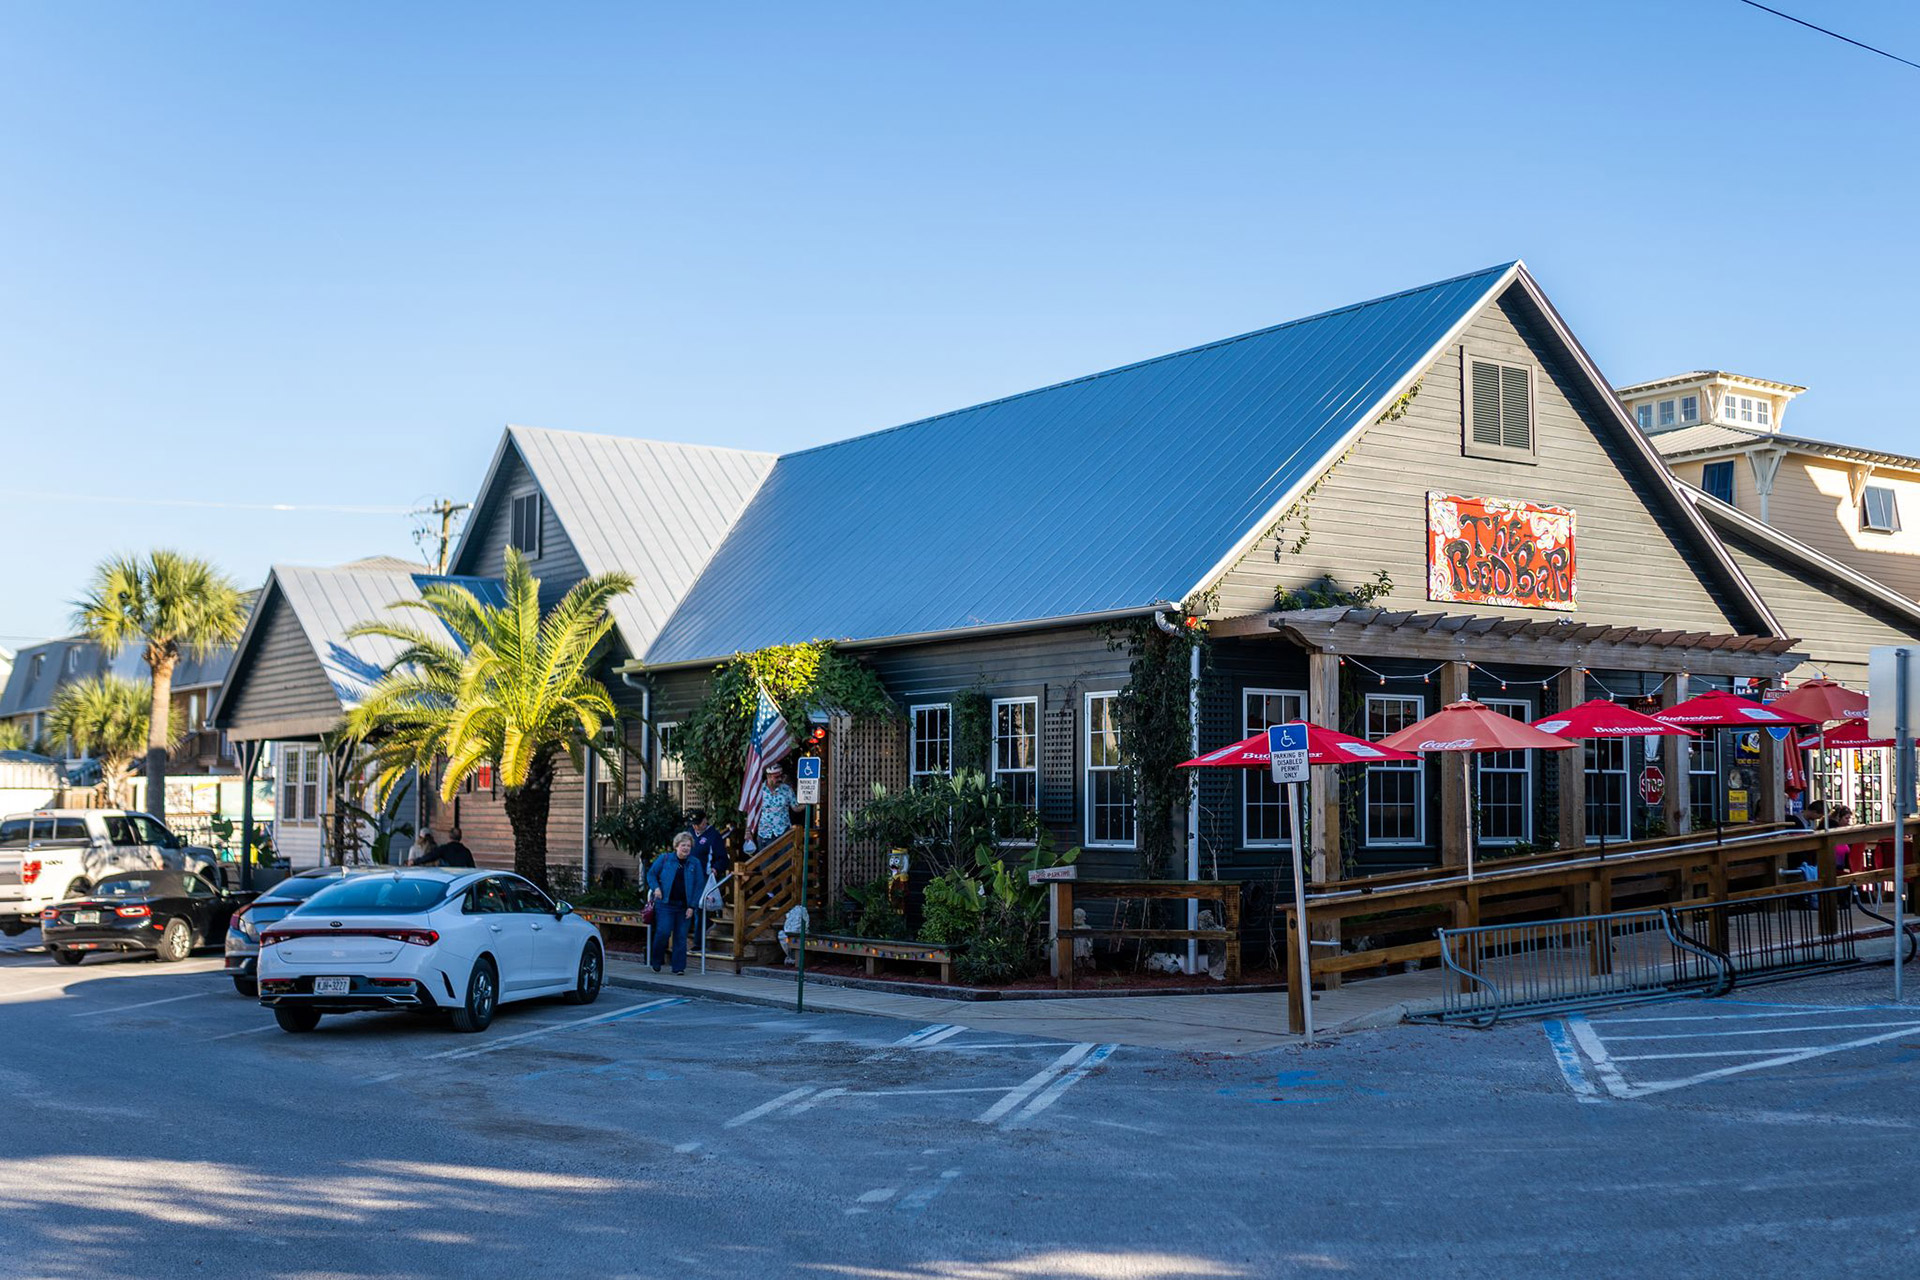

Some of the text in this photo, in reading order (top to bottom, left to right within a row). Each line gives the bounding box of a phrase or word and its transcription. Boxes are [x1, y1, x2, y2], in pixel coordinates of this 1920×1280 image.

[1418, 738, 1478, 750] Coca-Cola
[1276, 758, 1303, 766] DISABLED
[1641, 778, 1663, 793] STOP
